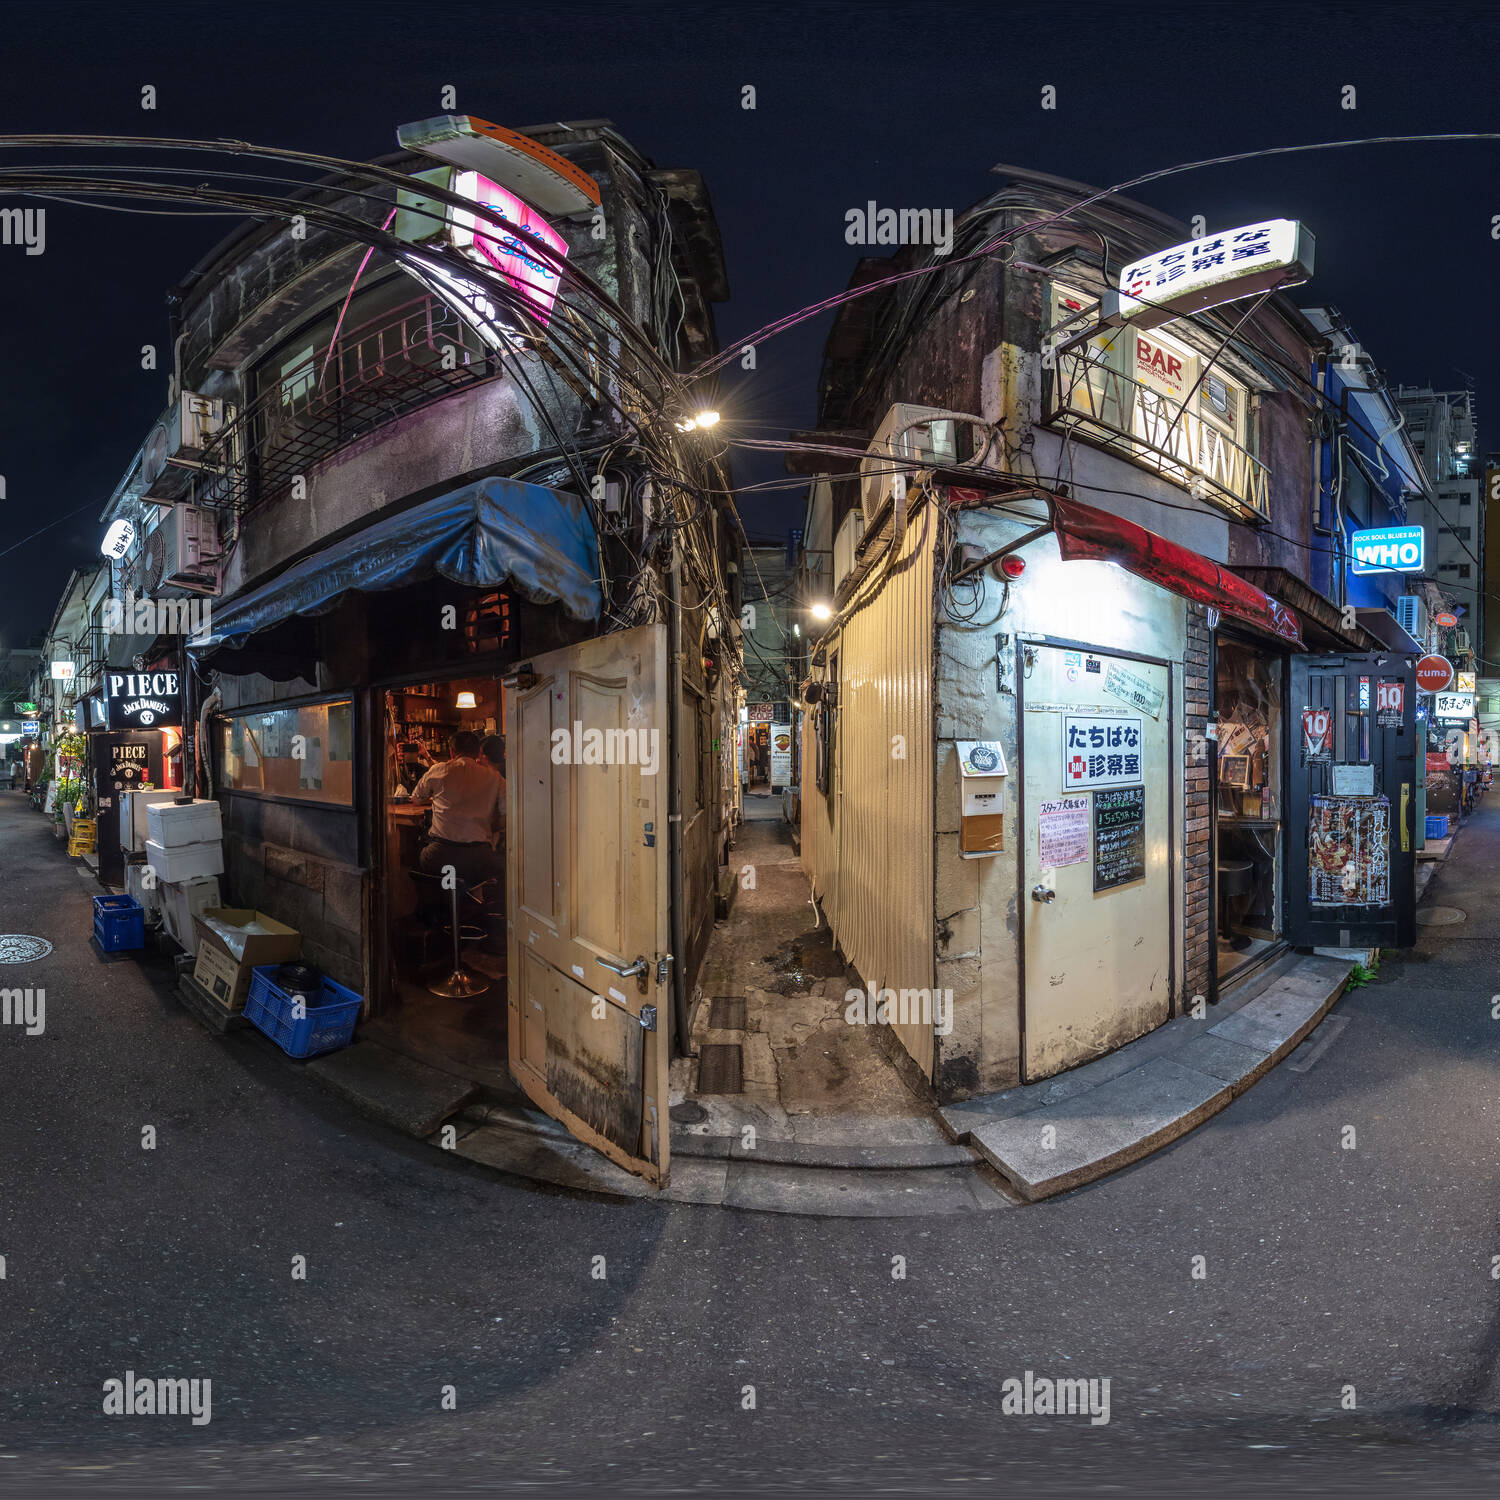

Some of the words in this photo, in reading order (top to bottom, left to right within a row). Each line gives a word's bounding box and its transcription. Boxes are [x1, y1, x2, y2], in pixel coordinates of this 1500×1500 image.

[1137, 338, 1182, 382] BAR
[113, 524, 134, 554] 日本酒
[1356, 543, 1419, 567] WHO
[1417, 669, 1450, 677] zuma.
[110, 674, 179, 697] PIECE
[123, 702, 140, 715] JACK
[140, 698, 169, 714] DANIEL'S
[1379, 687, 1401, 707] 10
[751, 712, 773, 720] SOUP
[1305, 714, 1328, 735] 10
[1068, 725, 1139, 748] たちばな
[112, 746, 146, 759] PIECE
[1071, 762, 1084, 772] BAR
[1088, 753, 1139, 778] 診察室
